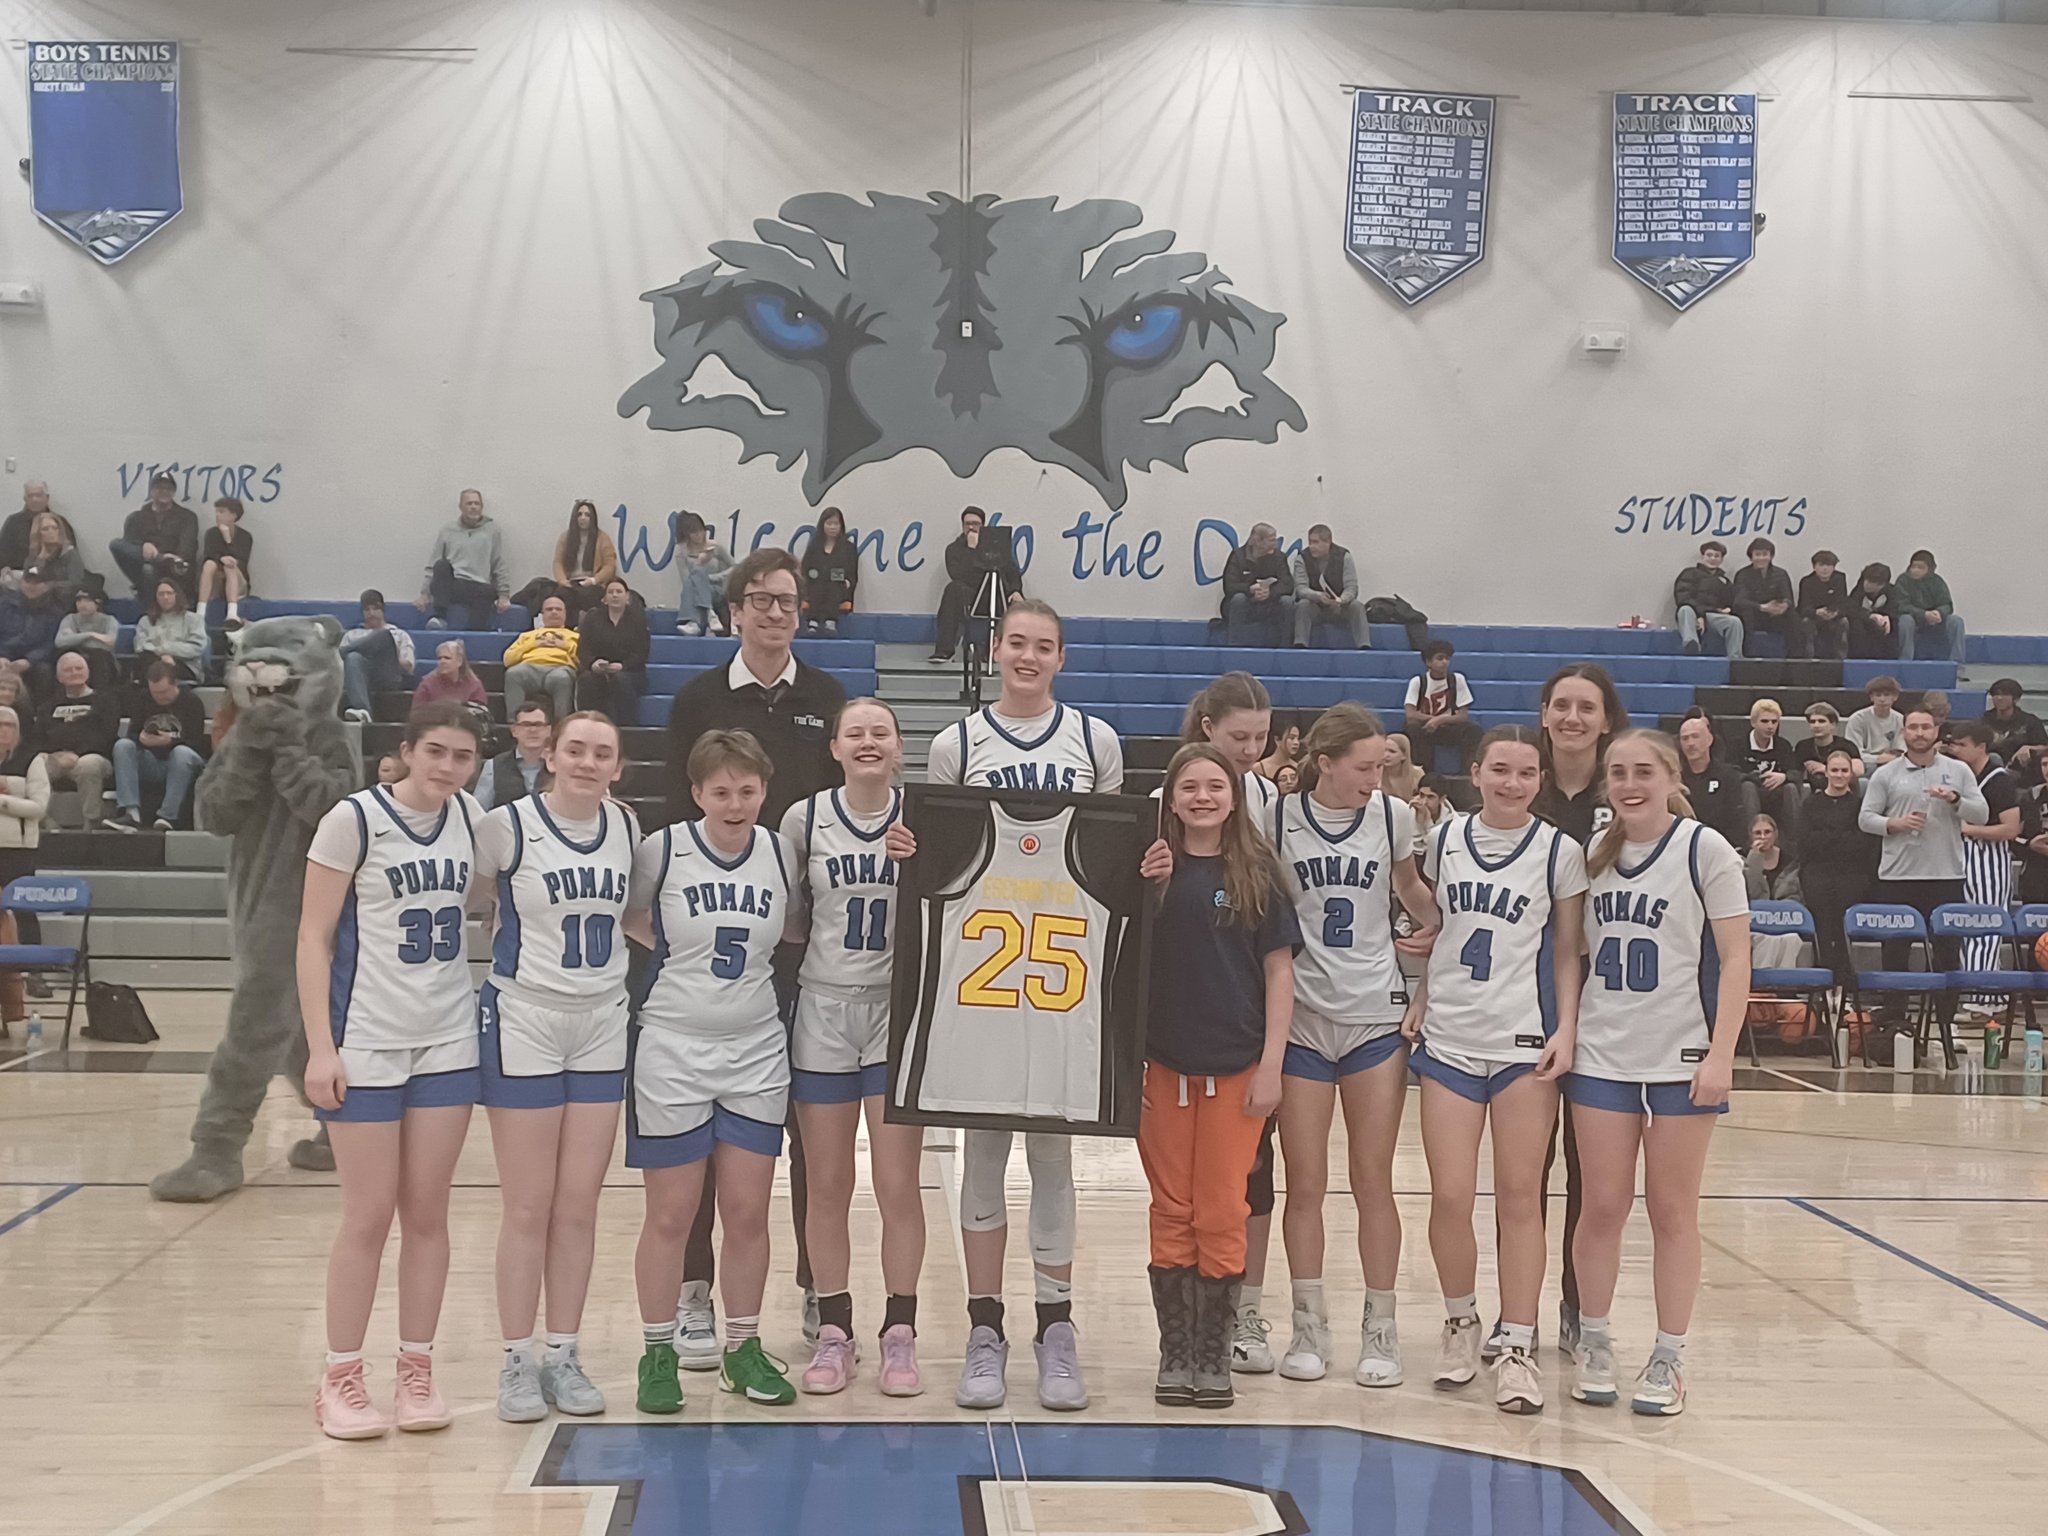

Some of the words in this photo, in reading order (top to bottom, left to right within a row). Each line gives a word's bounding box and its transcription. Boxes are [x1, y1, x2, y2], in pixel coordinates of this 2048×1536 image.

[31, 62, 78, 81] STATE
[80, 62, 175, 81] CHAMPIONS
[35, 45, 90, 61] BOYS
[97, 45, 170, 61] TENNIS
[1375, 95, 1473, 117] TRACK
[1631, 95, 1738, 112] TRACK
[1358, 111, 1399, 132] STATE
[1401, 115, 1487, 137] CHAMPIONS
[1617, 114, 1660, 132] STATE
[1663, 114, 1754, 133] CHAMPIONS
[1615, 493, 1807, 536] STUDENTS
[1062, 511, 1164, 580] the
[985, 762, 1077, 793] PUMAS
[384, 858, 469, 899] PUMAS
[542, 866, 626, 905] PUMAS
[825, 853, 898, 889] PUMA
[1294, 855, 1379, 892] PUMAS
[13, 886, 78, 901] PUMAS
[682, 882, 773, 919] PUMAS
[1446, 881, 1531, 924] PUMAS
[1593, 890, 1669, 929] PUMAS
[398, 905, 462, 964] 33
[844, 897, 888, 951] 11
[1322, 897, 1354, 948] 2
[1856, 913, 1915, 928] PUMAS
[1943, 913, 2003, 928] PUMAS
[561, 913, 615, 968] 10
[710, 926, 750, 980] 5
[1460, 927, 1494, 982] 4
[957, 909, 1088, 1012] 25
[1595, 937, 1659, 993] 40
